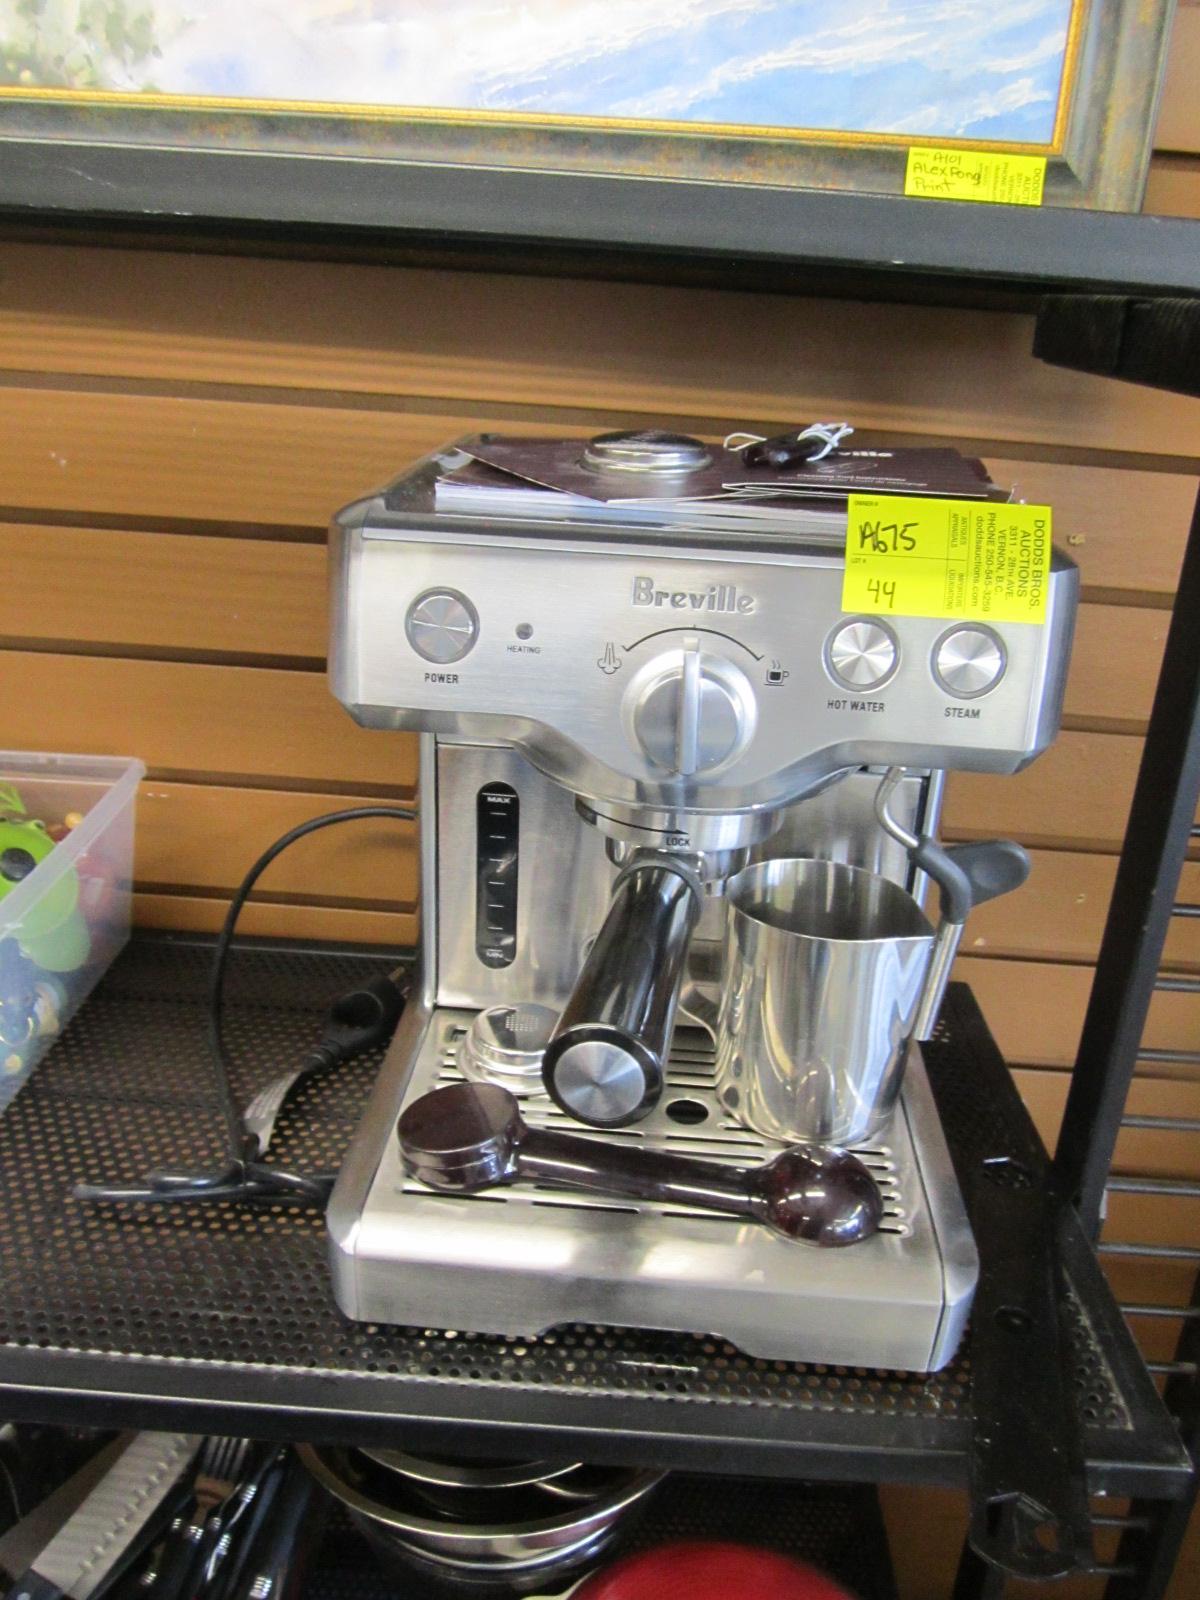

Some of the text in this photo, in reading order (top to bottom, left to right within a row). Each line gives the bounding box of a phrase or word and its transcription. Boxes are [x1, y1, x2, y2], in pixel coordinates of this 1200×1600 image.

[986, 513, 996, 546] PHONE
[1009, 525, 1018, 546] 3311
[971, 516, 984, 607] doddsauctions.com
[1016, 530, 1031, 597] AUCTIONS
[1029, 519, 1045, 610] DODDS BROS.
[632, 576, 756, 615] Breville
[867, 579, 896, 608] 44
[507, 645, 542, 654] HEATING
[424, 673, 459, 684] POWER
[827, 700, 885, 712] HOT WATER
[944, 707, 981, 719] STEAM
[487, 796, 511, 804] MAX
[666, 837, 690, 846] LOCK
